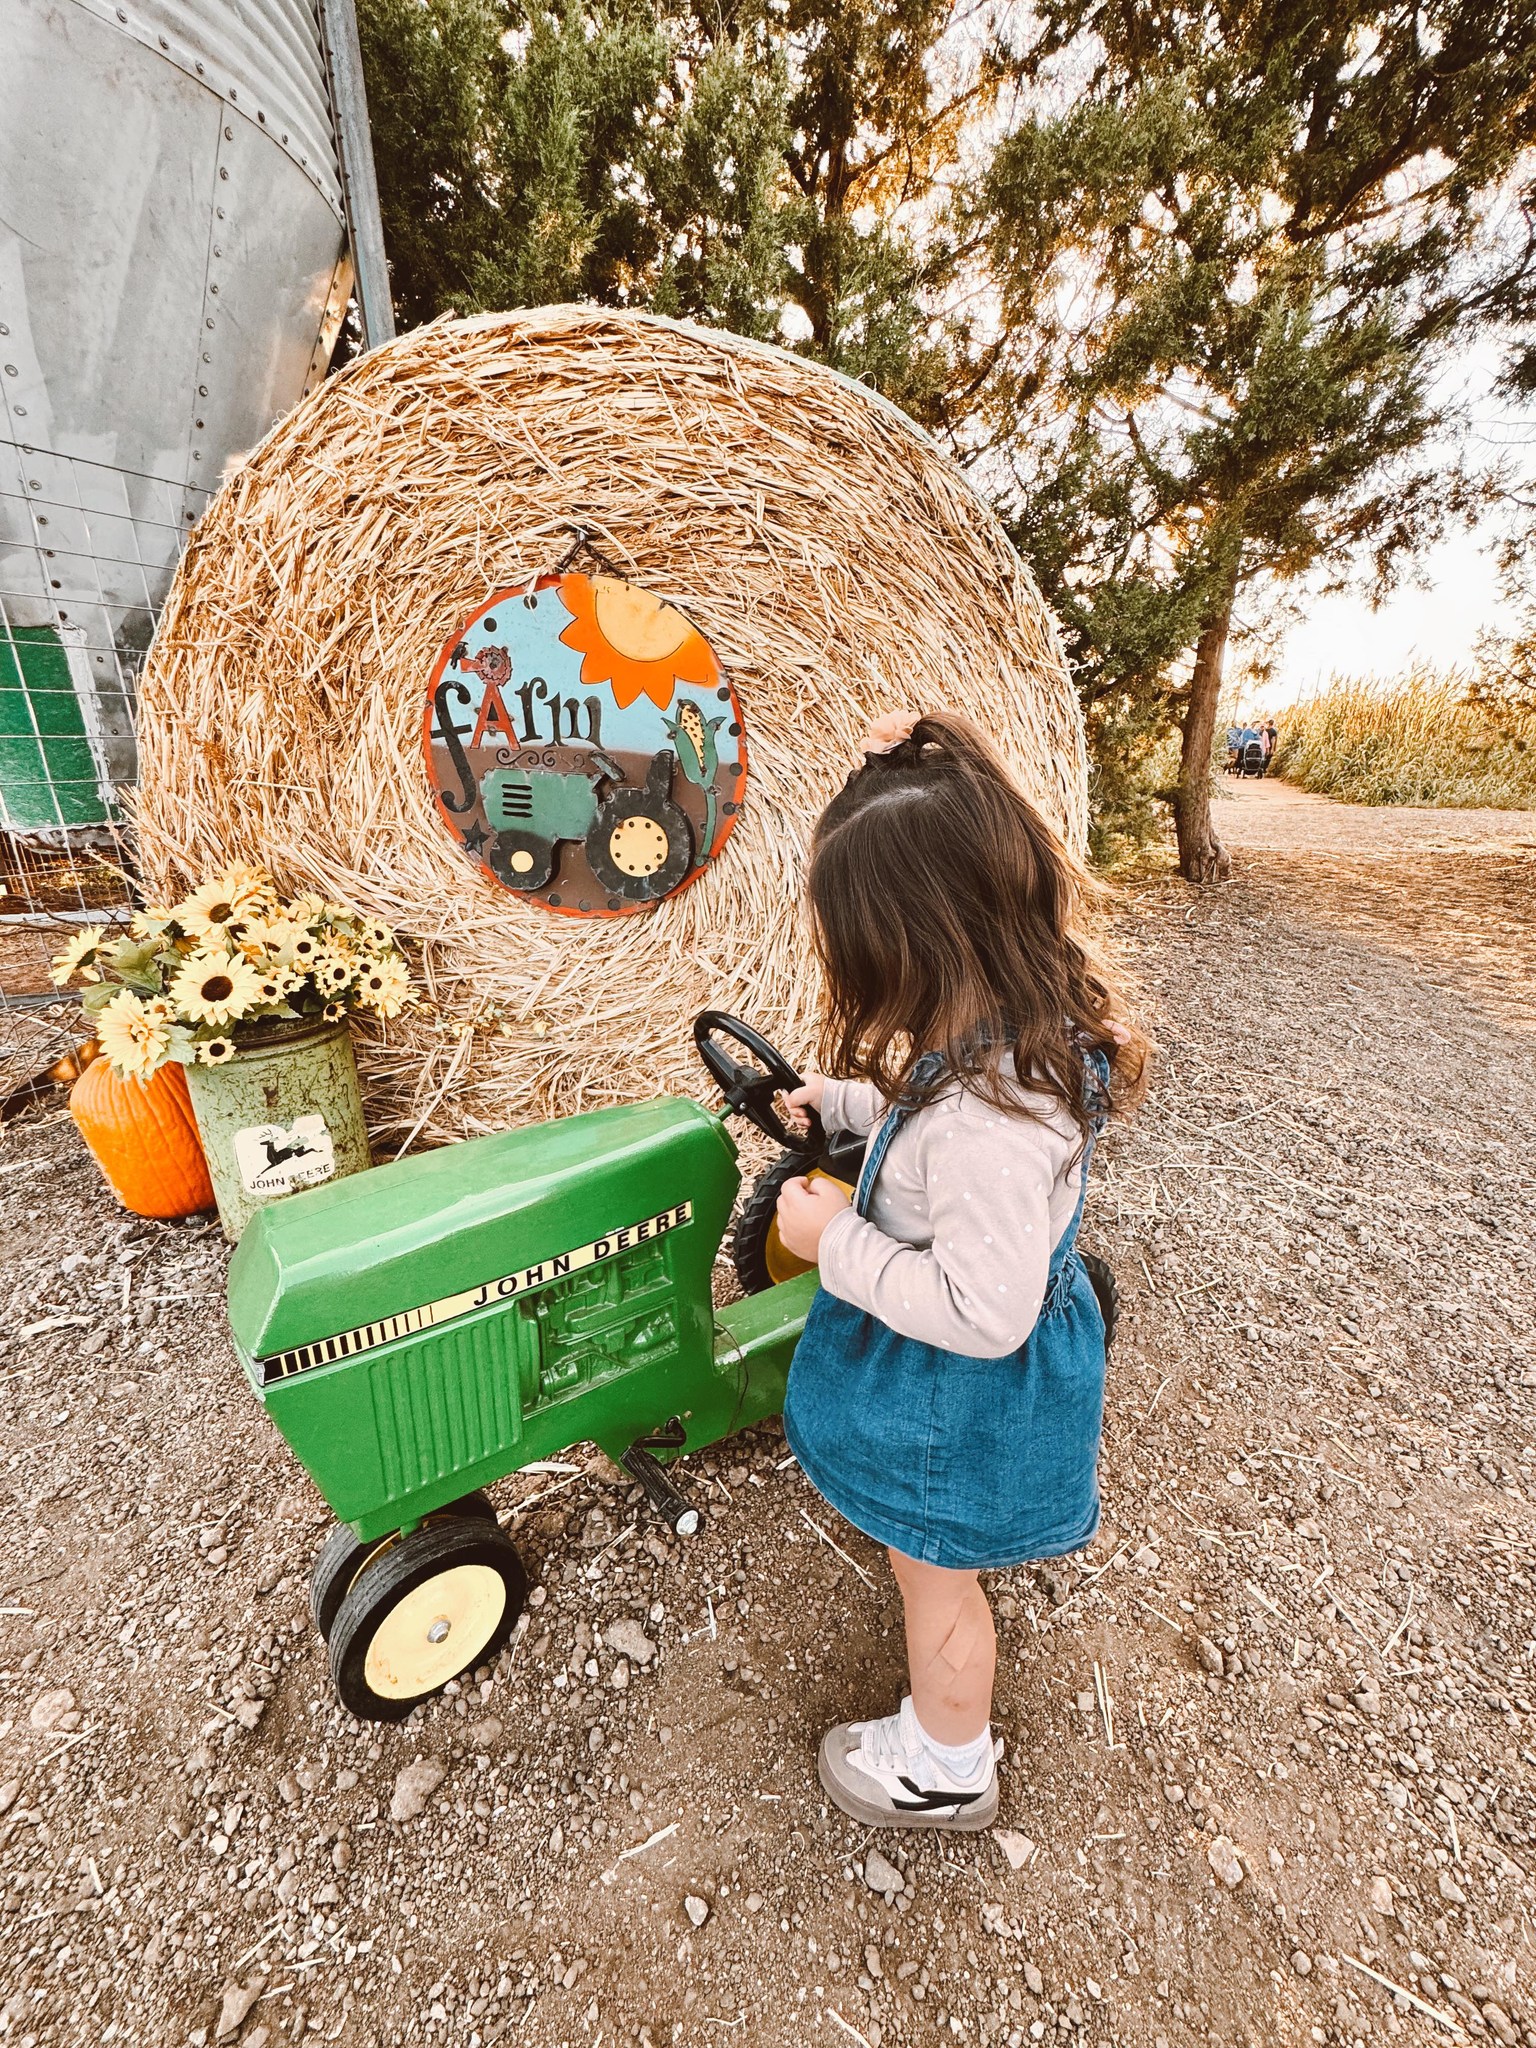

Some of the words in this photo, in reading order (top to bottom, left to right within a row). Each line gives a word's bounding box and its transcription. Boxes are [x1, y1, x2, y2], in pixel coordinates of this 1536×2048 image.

[250, 1177, 285, 1189] JOHN
[289, 1164, 331, 1186] EERE
[474, 1255, 570, 1306] JOHN
[594, 1204, 687, 1260] DEERE
